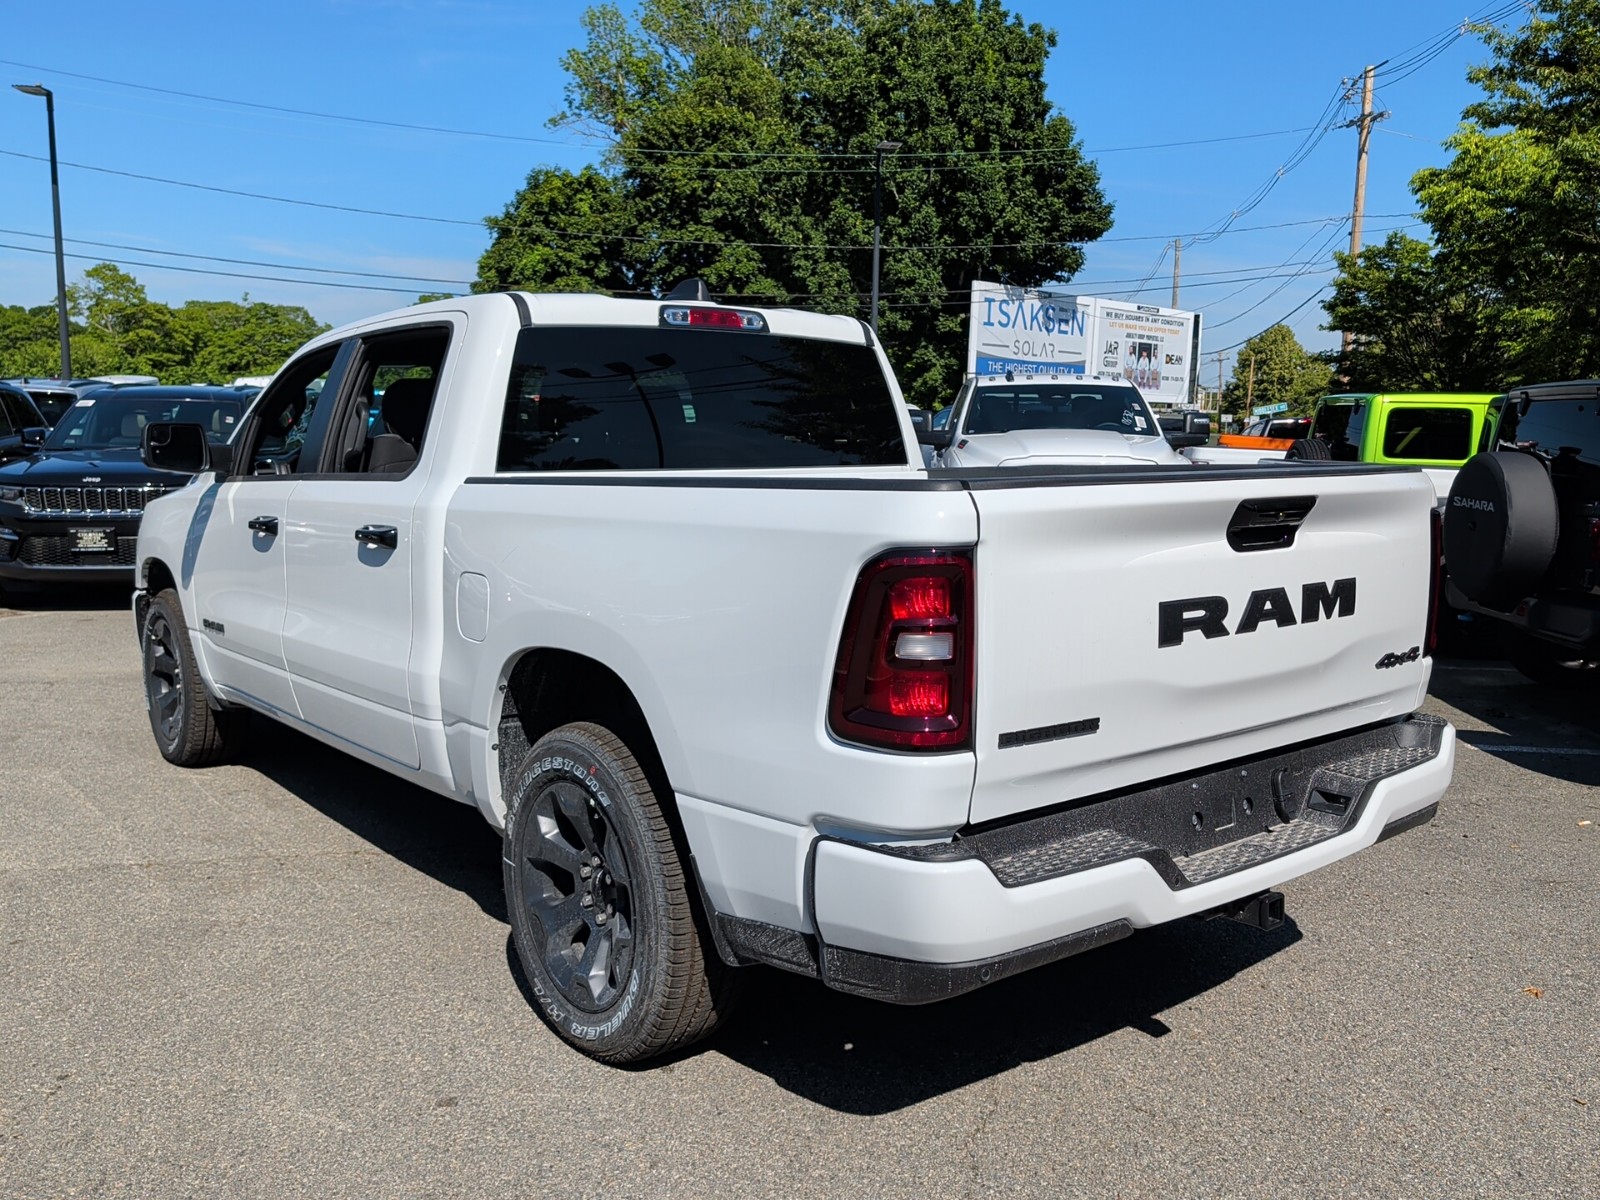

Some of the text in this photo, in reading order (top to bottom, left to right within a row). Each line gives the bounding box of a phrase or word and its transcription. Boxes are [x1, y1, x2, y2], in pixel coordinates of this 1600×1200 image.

[983, 297, 1085, 337] ISAKSEN
[1105, 311, 1114, 319] WE
[1114, 312, 1124, 320] BUY
[1144, 315, 1150, 323] IN
[1161, 319, 1184, 328] CONDITION
[1109, 321, 1118, 329] LET
[1118, 322, 1125, 330] US
[1125, 323, 1138, 331] MAKE
[1012, 339, 1056, 359] SOLAR
[1103, 340, 1119, 355] JAR
[988, 361, 1004, 373] THE
[1005, 361, 1037, 375] HIGHEST
[1038, 365, 1069, 375] QUALITY
[1165, 353, 1184, 366] DEAN
[1453, 495, 1495, 513] SAHARA
[1157, 576, 1357, 649] RAM
[1375, 645, 1420, 670] 4x4
[571, 968, 640, 1041] DUELER
